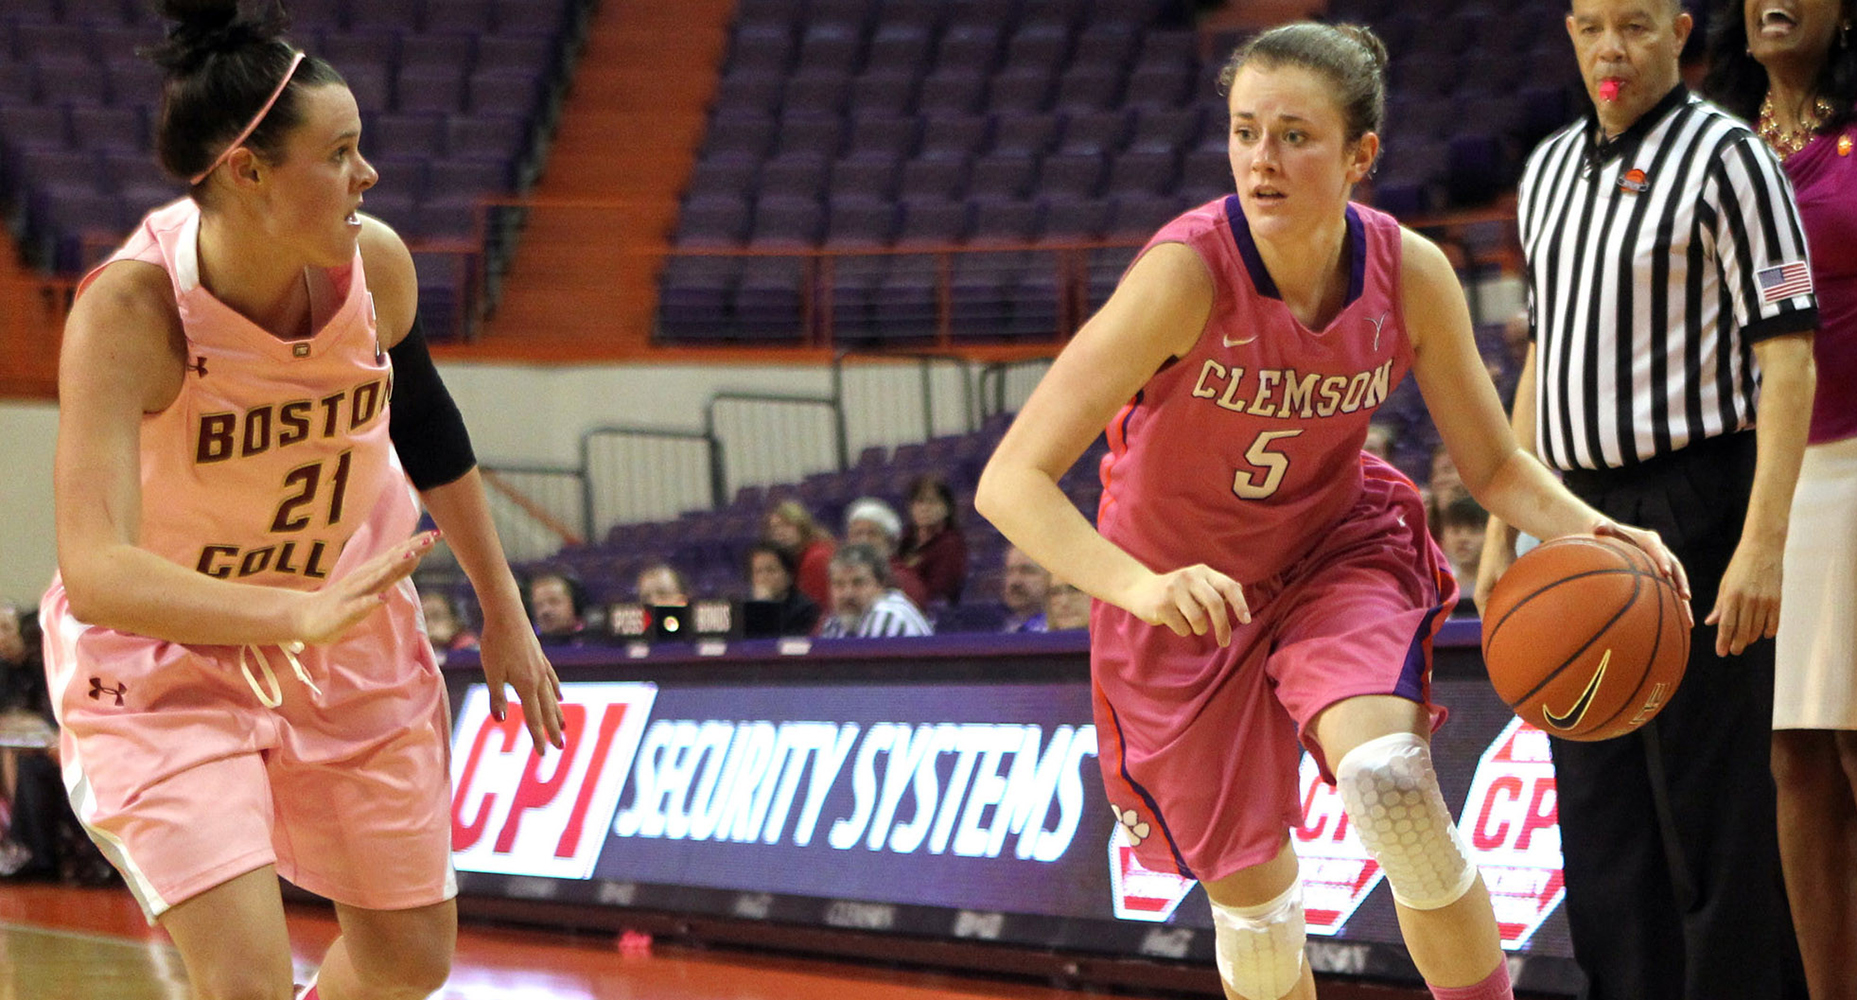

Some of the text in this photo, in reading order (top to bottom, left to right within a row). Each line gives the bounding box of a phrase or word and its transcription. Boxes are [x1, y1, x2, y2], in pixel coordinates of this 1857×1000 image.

[1191, 358, 1394, 420] CLEMSON
[269, 449, 352, 533] 21
[1230, 429, 1304, 500] 5
[195, 539, 350, 580] COLL
[451, 701, 1099, 863] CPI SECURITY SYSTEMS
[1472, 774, 1558, 852] CP
